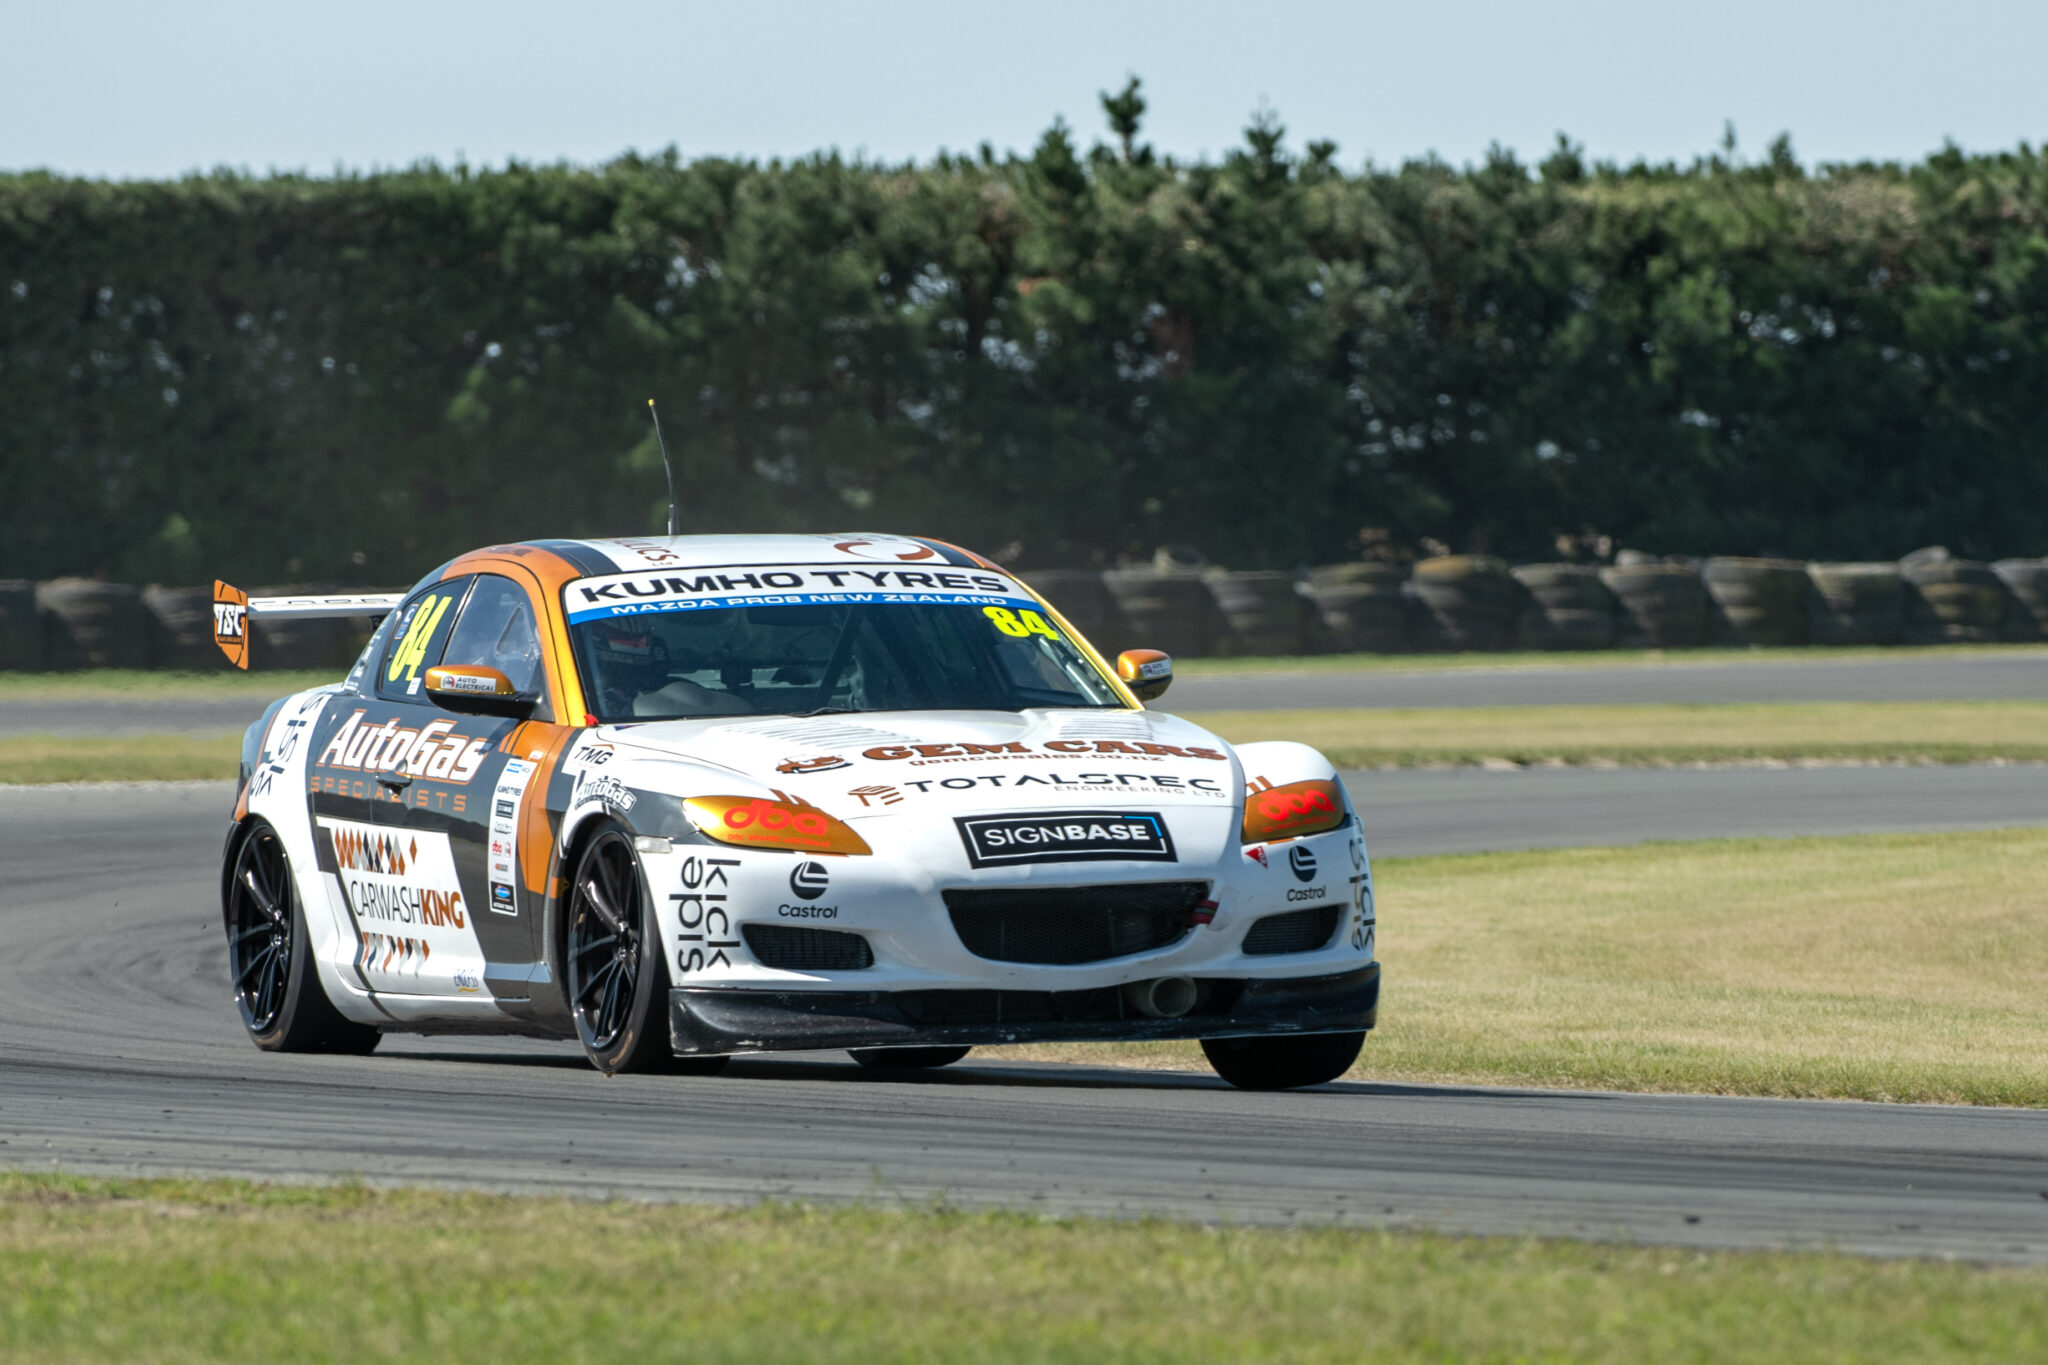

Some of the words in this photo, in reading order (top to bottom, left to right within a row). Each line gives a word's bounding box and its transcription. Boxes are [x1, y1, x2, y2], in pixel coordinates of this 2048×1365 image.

[580, 572, 804, 602] KUMHO
[810, 571, 1009, 593] TYRES
[611, 599, 721, 615] MAZDA
[809, 593, 873, 603] NEW
[882, 593, 1008, 606] ZEALAND
[213, 604, 246, 636] TSC
[982, 606, 1061, 641] 84
[388, 594, 453, 682] 84
[316, 709, 492, 786] AutoGas
[574, 746, 613, 765] TMG
[862, 742, 1033, 761] GEM
[1043, 740, 1228, 761] CARS
[908, 753, 1164, 766] gemcarsales.co.nz
[904, 773, 1221, 792] TOTALSPEC
[1053, 785, 1186, 795] ENGINEERING
[1193, 790, 1226, 798] LTD
[723, 799, 828, 837] dba
[984, 824, 1151, 847] SIGNBASE
[1286, 885, 1327, 902] Castrol
[705, 858, 741, 969] kick
[778, 903, 838, 919] Castrol
